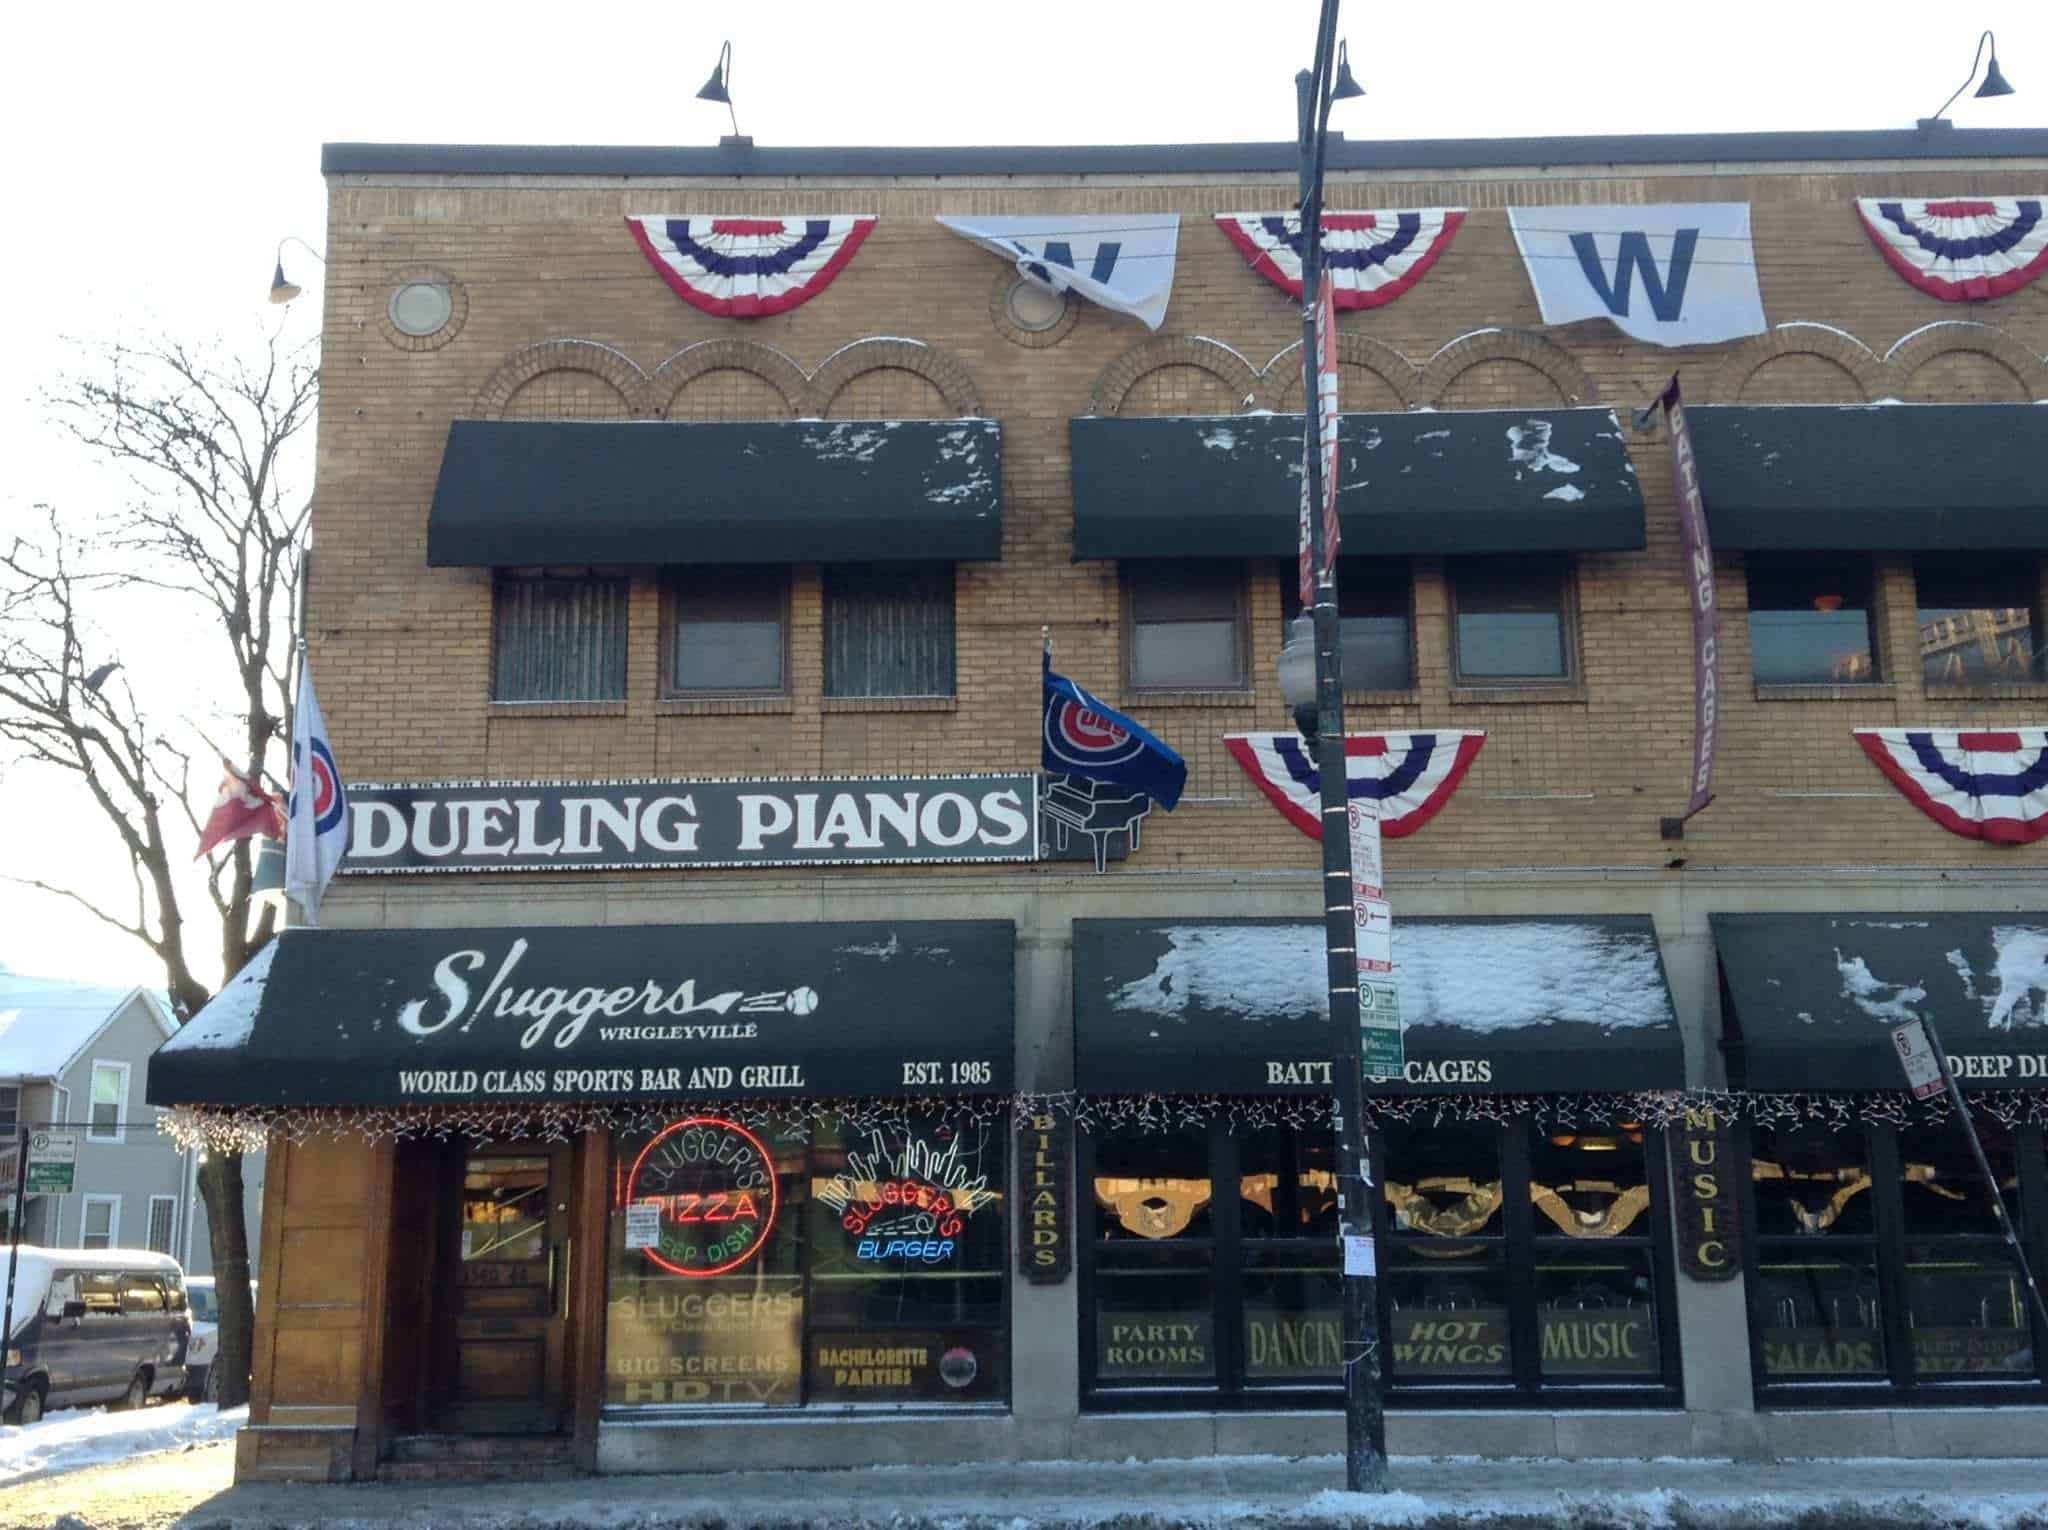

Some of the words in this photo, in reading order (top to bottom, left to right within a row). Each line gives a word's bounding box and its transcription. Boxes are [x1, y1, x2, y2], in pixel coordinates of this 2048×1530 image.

[1568, 228, 1700, 322] W
[1670, 402, 1713, 610] BATTING
[1696, 636, 1716, 792] CAGES
[347, 792, 699, 859] DUELING
[737, 788, 1029, 852] PIANOS
[400, 937, 745, 1049] Sluggers
[600, 1022, 758, 1041] WRIGLEYVILLE
[400, 1071, 477, 1093] WORLD
[483, 1070, 545, 1092] CLASS
[553, 1069, 633, 1091] SPORTS
[640, 1068, 681, 1090] BAR
[688, 1067, 732, 1089] AND
[740, 1065, 805, 1087] GRILL
[902, 1062, 944, 1086] EST.
[949, 1061, 991, 1085] 1985
[1404, 1060, 1492, 1084] CAGES
[1945, 1055, 2013, 1078] DEEP
[1032, 1113, 1058, 1266] BILLARDS
[1685, 1107, 1725, 1266] MUSIC
[707, 1223, 753, 1262] DISH
[857, 1241, 954, 1259] BURGER
[615, 1293, 794, 1320] SLUGGERS
[1112, 1324, 1199, 1341] PARTY
[1250, 1321, 1344, 1367] DANCIN
[1409, 1321, 1488, 1342] HOT
[1542, 1321, 1639, 1361] MUSIC
[617, 1357, 660, 1375] BIG
[669, 1356, 788, 1375] SCREENS
[819, 1348, 928, 1367] BACHELORETTE
[1106, 1346, 1206, 1364] ROOMS
[1392, 1343, 1505, 1364] WINGS
[834, 1368, 913, 1386] PARTIES
